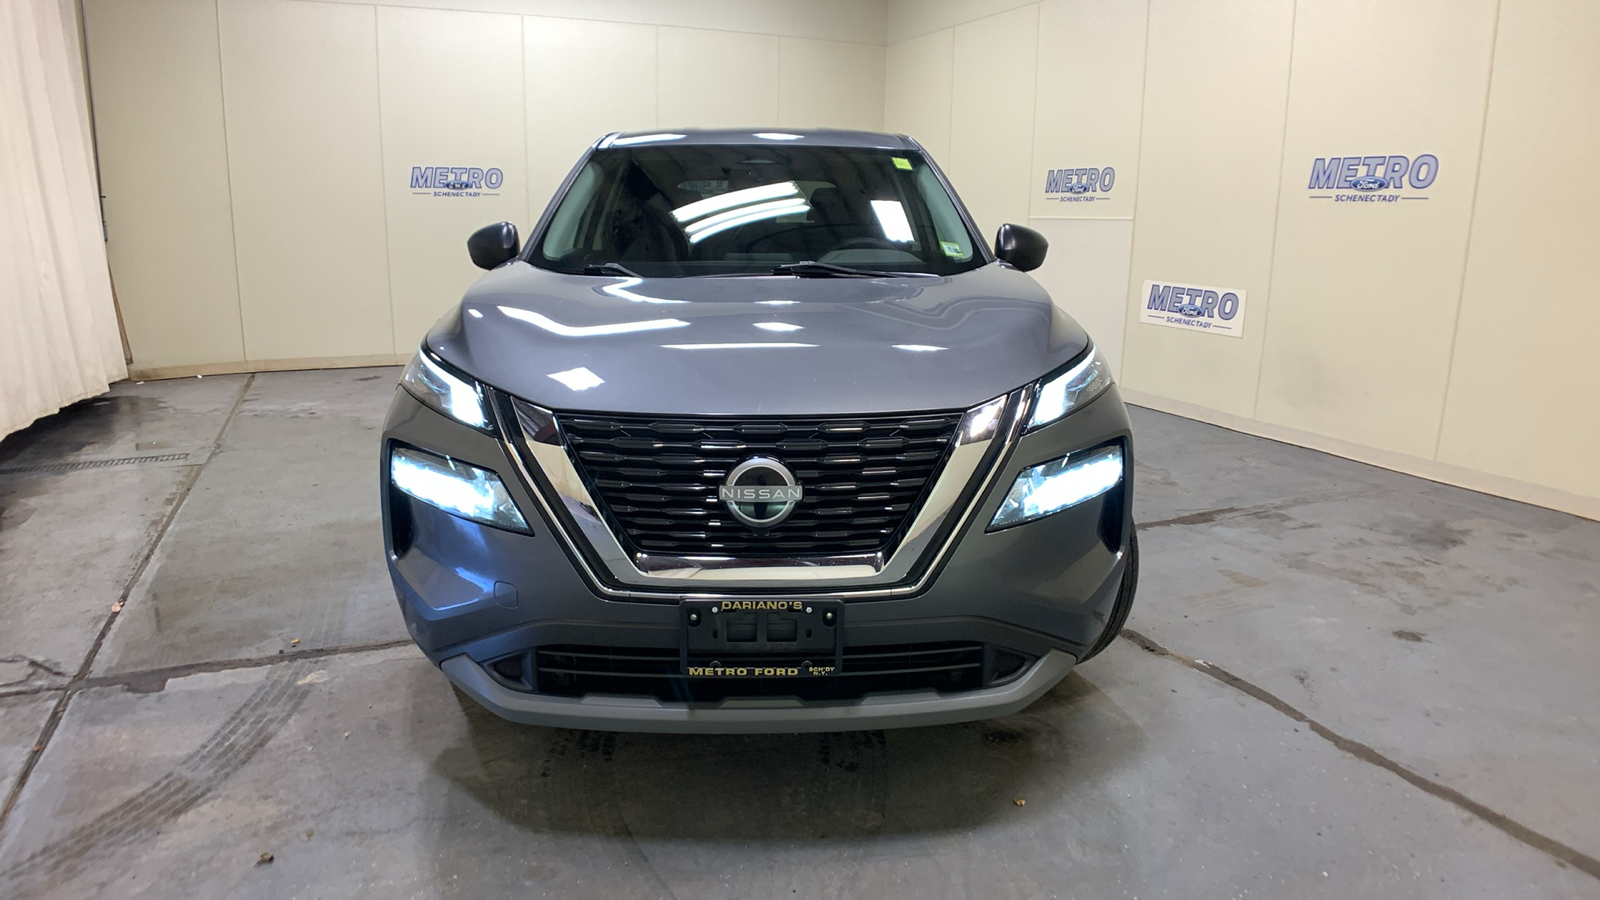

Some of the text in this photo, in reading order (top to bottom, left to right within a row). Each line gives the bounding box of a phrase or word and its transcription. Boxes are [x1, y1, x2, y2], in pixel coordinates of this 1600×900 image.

[1308, 153, 1439, 190] METRO
[410, 166, 504, 190] METRO
[1045, 166, 1116, 193] METRO
[1356, 178, 1381, 190] Ford
[1334, 194, 1400, 203] SCHENECTADY
[1147, 284, 1240, 321] METRO
[1166, 316, 1212, 329] SCHENECTADY
[722, 488, 800, 499] NISSAN
[721, 601, 803, 610] DARIANO'S
[688, 667, 799, 676] METRO FORD
